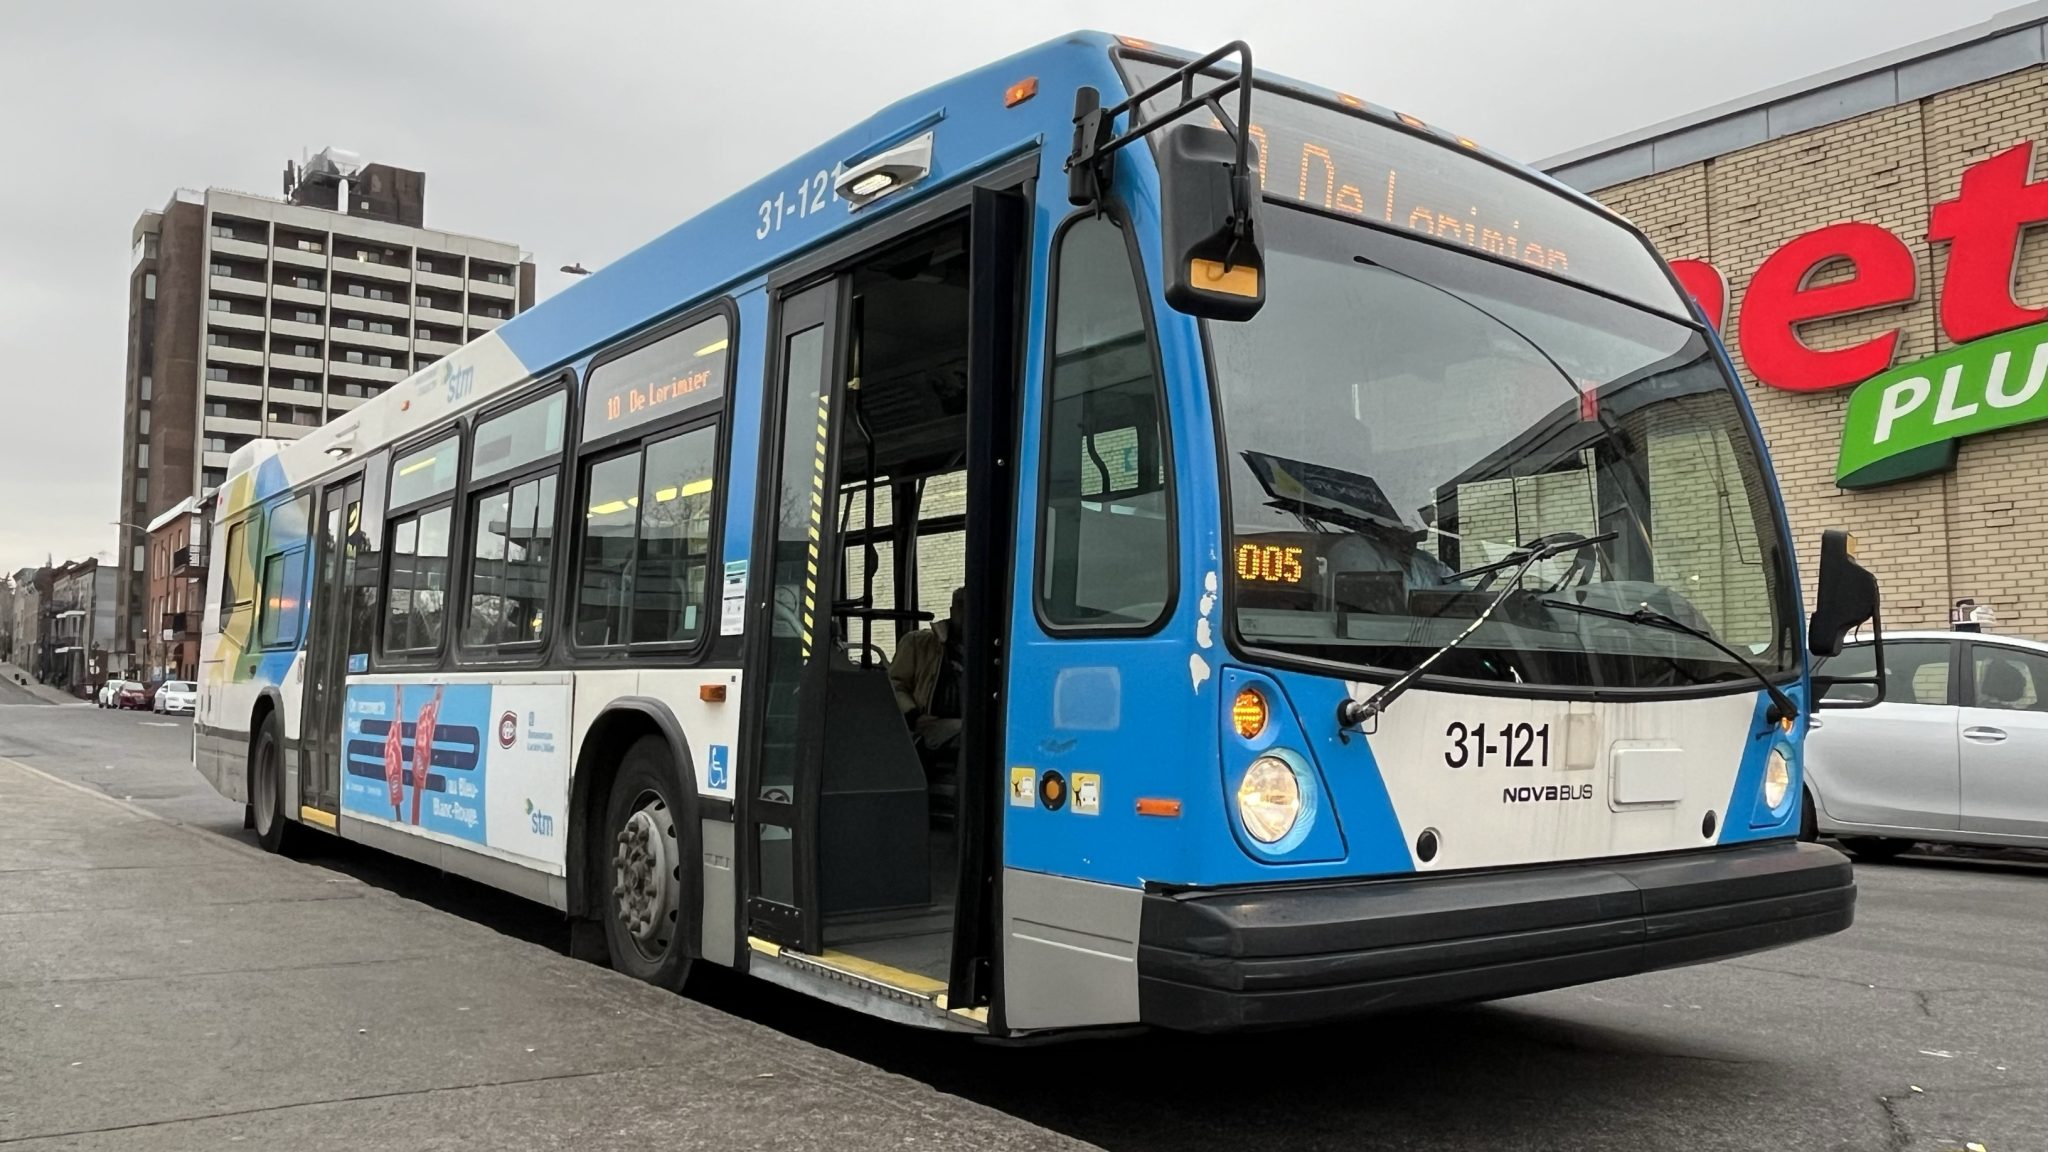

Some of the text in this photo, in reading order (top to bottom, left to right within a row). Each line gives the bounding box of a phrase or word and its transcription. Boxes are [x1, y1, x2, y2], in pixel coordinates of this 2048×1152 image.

[756, 161, 845, 240] 31-121
[1668, 140, 2048, 394] et
[447, 364, 474, 403] stm
[608, 370, 710, 420] 10 De Lorimier
[1237, 544, 1302, 582] 005
[1444, 721, 1549, 769] 31-121
[531, 809, 554, 837] stm
